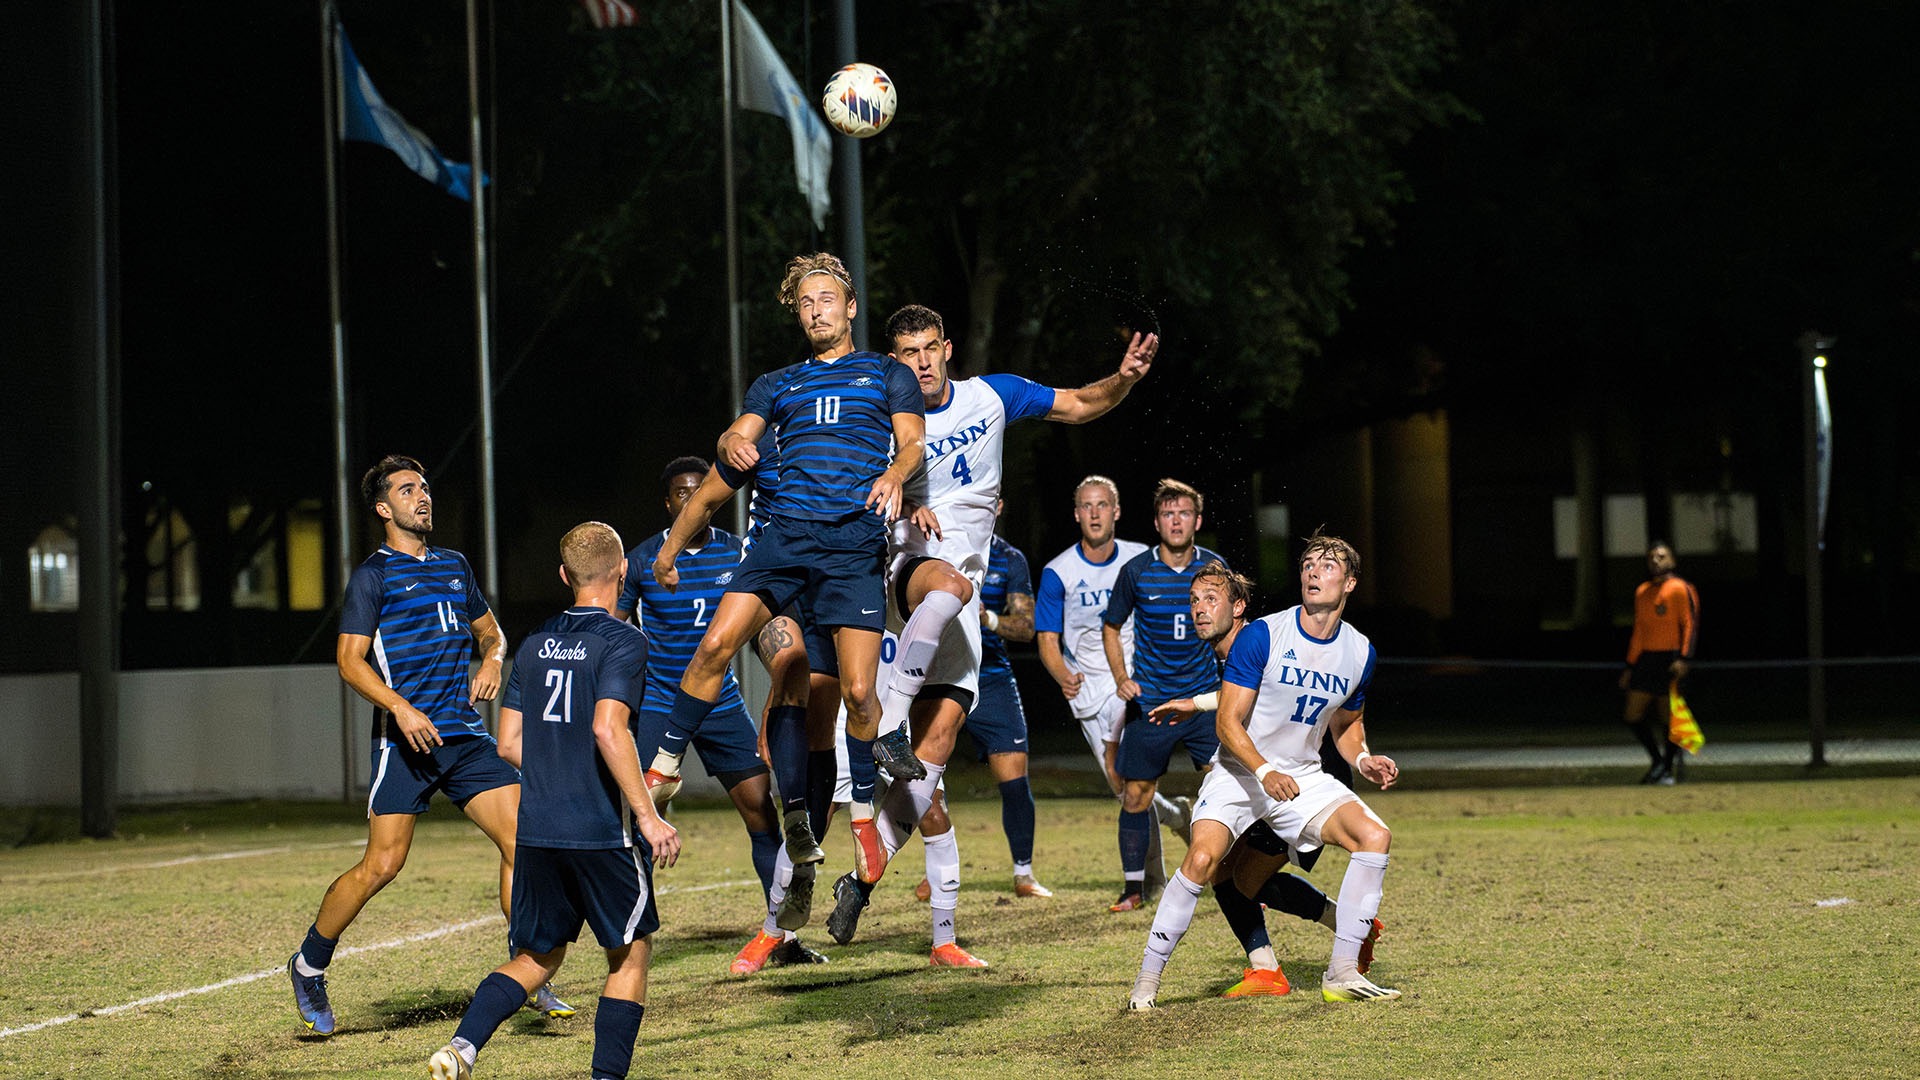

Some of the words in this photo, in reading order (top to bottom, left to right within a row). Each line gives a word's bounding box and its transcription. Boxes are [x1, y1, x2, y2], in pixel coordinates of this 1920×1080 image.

[816, 396, 840, 425] 10
[951, 453, 973, 487] 4
[437, 601, 459, 632] 14
[693, 598, 707, 627] 2
[1174, 613, 1186, 640] 6
[538, 638, 587, 660] Sharks
[542, 669, 573, 723] 21
[1278, 665, 1350, 697] LYNN
[1290, 694, 1329, 726] 17
